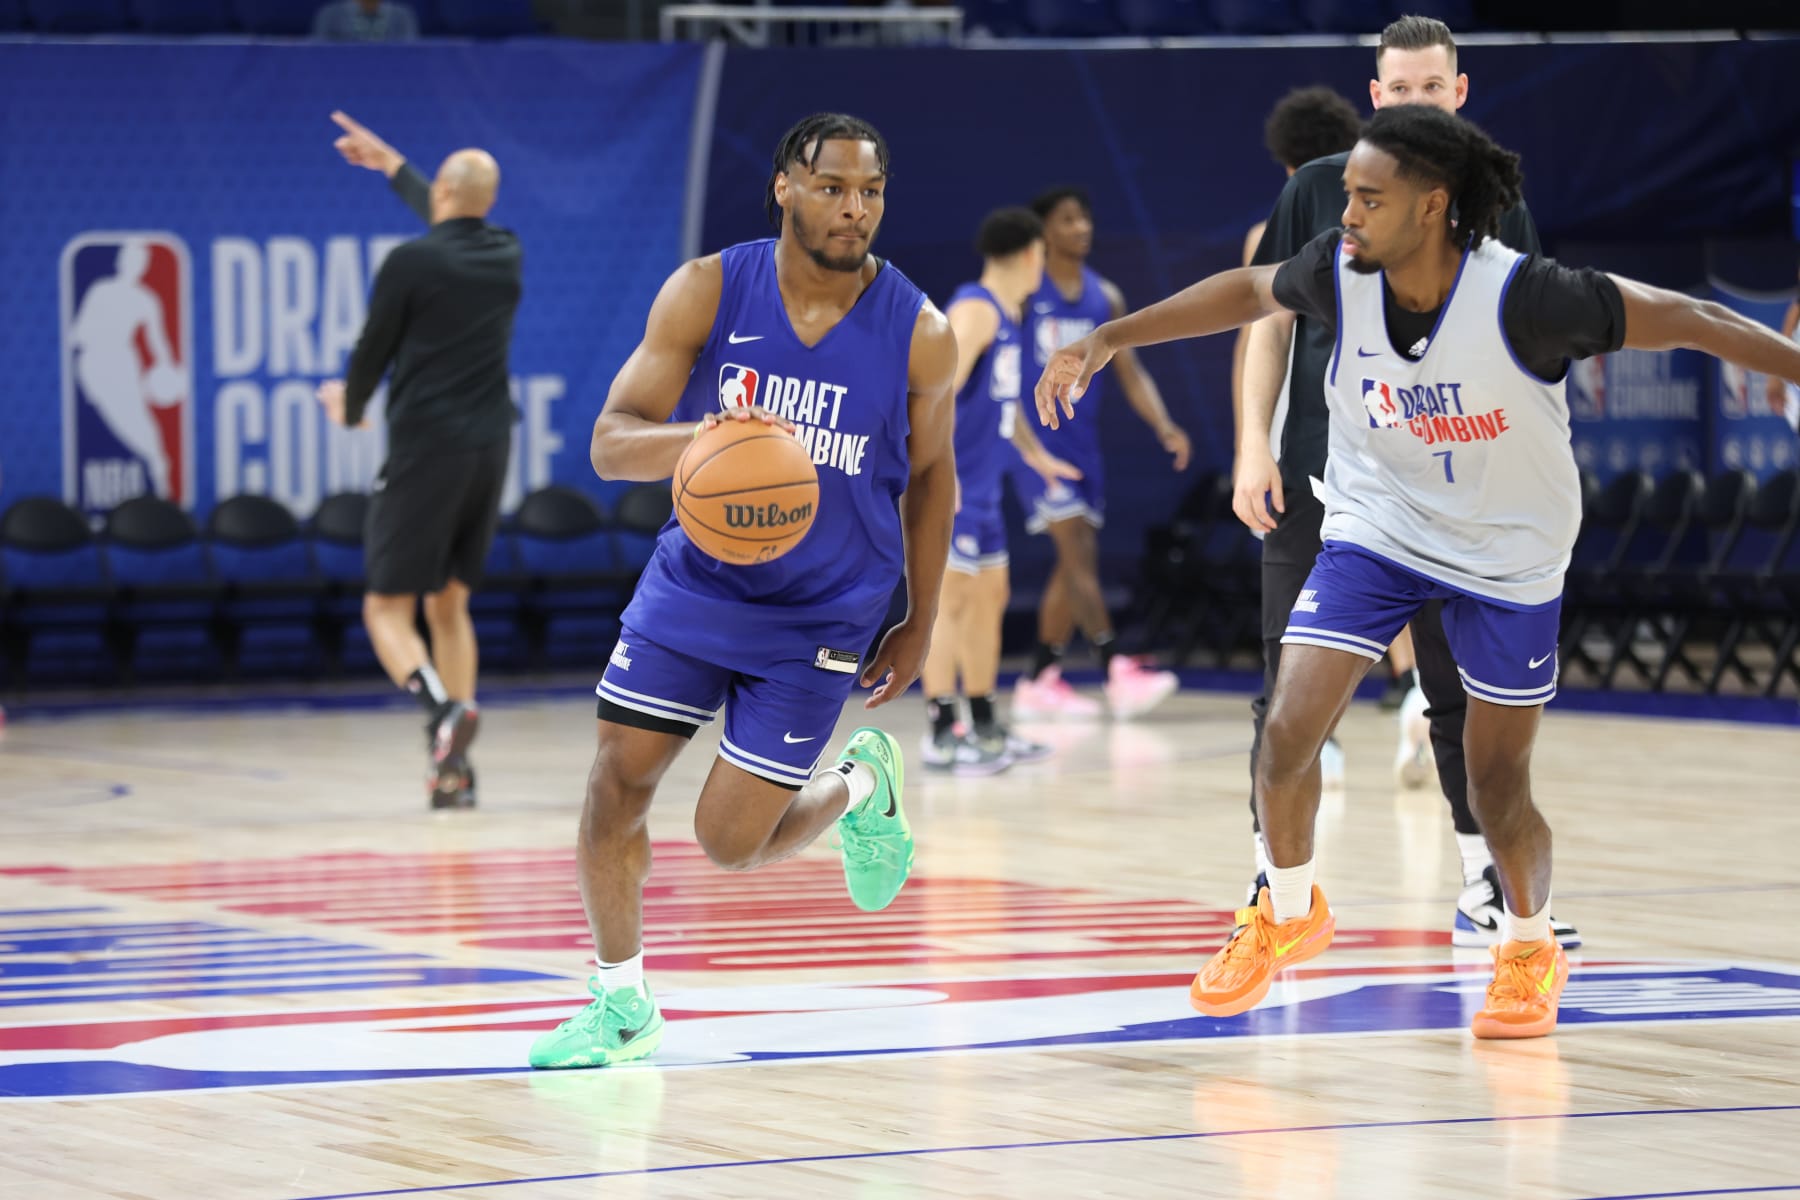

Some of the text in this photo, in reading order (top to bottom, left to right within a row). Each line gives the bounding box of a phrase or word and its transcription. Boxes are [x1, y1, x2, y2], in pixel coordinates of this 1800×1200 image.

[211, 235, 421, 377] DRA
[763, 374, 848, 429] DRAFT
[1397, 383, 1464, 419] DRAFT
[1408, 408, 1510, 445] COMBINE
[794, 423, 870, 476] MBINE
[1432, 450, 1455, 484] 7
[723, 502, 813, 529] Wilson
